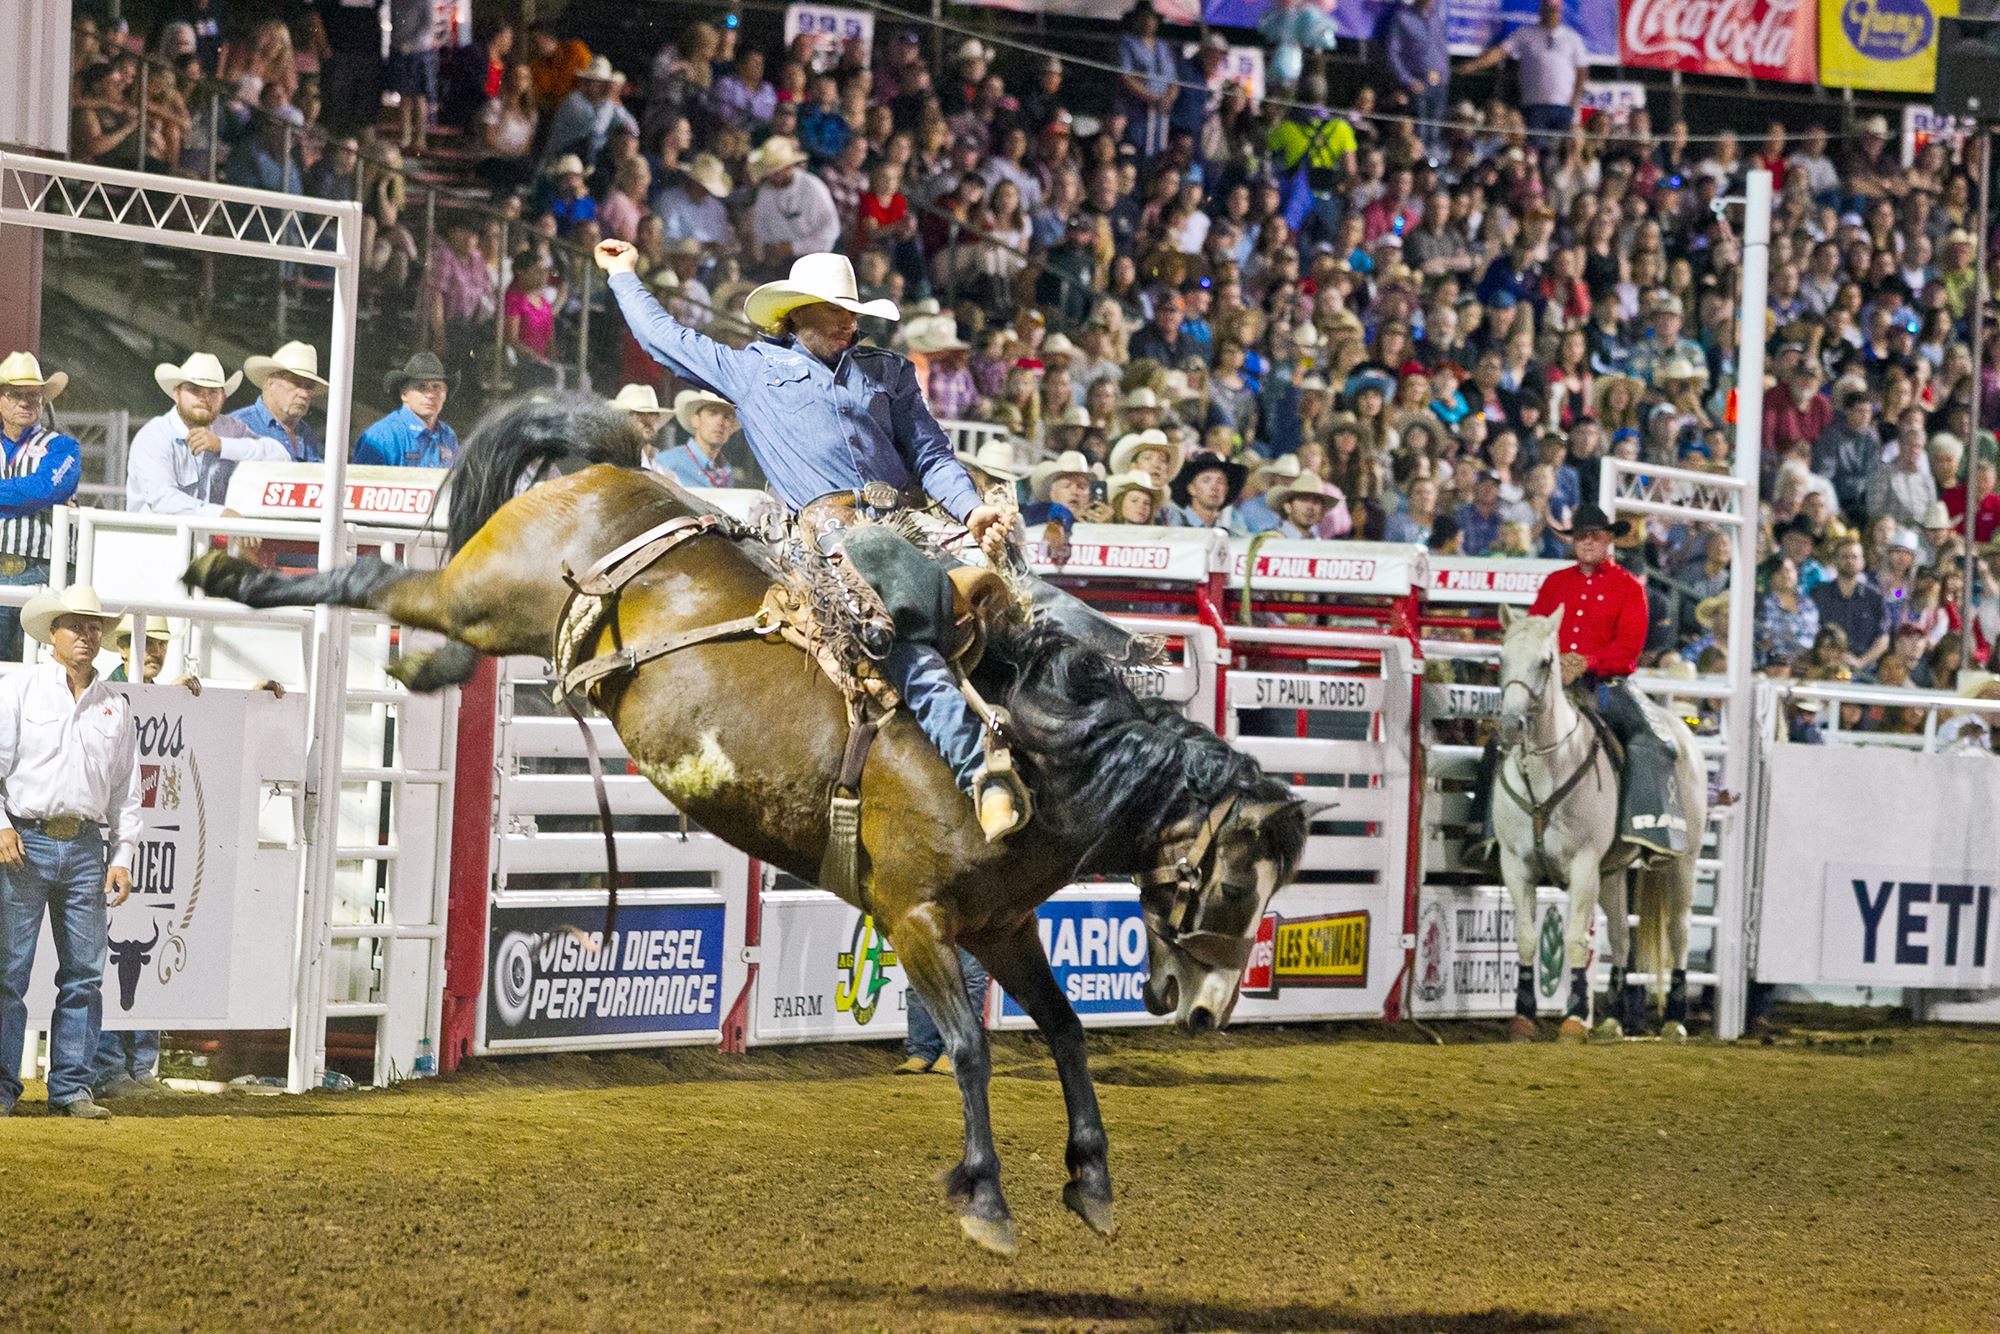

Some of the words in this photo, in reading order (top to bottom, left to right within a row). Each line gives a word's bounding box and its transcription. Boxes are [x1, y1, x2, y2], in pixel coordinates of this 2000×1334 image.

[264, 483, 297, 506] ST.
[302, 484, 355, 509] PL
[360, 487, 433, 514] RODEO
[1069, 545, 1105, 566] AUL
[1106, 547, 1169, 569] RODEO
[1268, 557, 1313, 579] PAUL
[1315, 559, 1375, 581] RODEO
[1448, 571, 1491, 591] PAUL
[1126, 674, 1165, 698] DEO
[1256, 678, 1272, 702] ST
[1278, 679, 1314, 705] PAUL
[1319, 681, 1366, 706] RODEO
[1448, 689, 1466, 714] ST
[123, 693, 184, 758] ors
[102, 840, 176, 893] RDEO
[1852, 879, 1990, 967] YETI
[538, 930, 620, 973] VISION
[622, 929, 705, 971] DIESEL
[1278, 928, 1302, 968] LES
[528, 974, 717, 1020] PERFORMANCE
[1066, 972, 1145, 1002] SERVIC
[773, 995, 823, 1018] FARM
